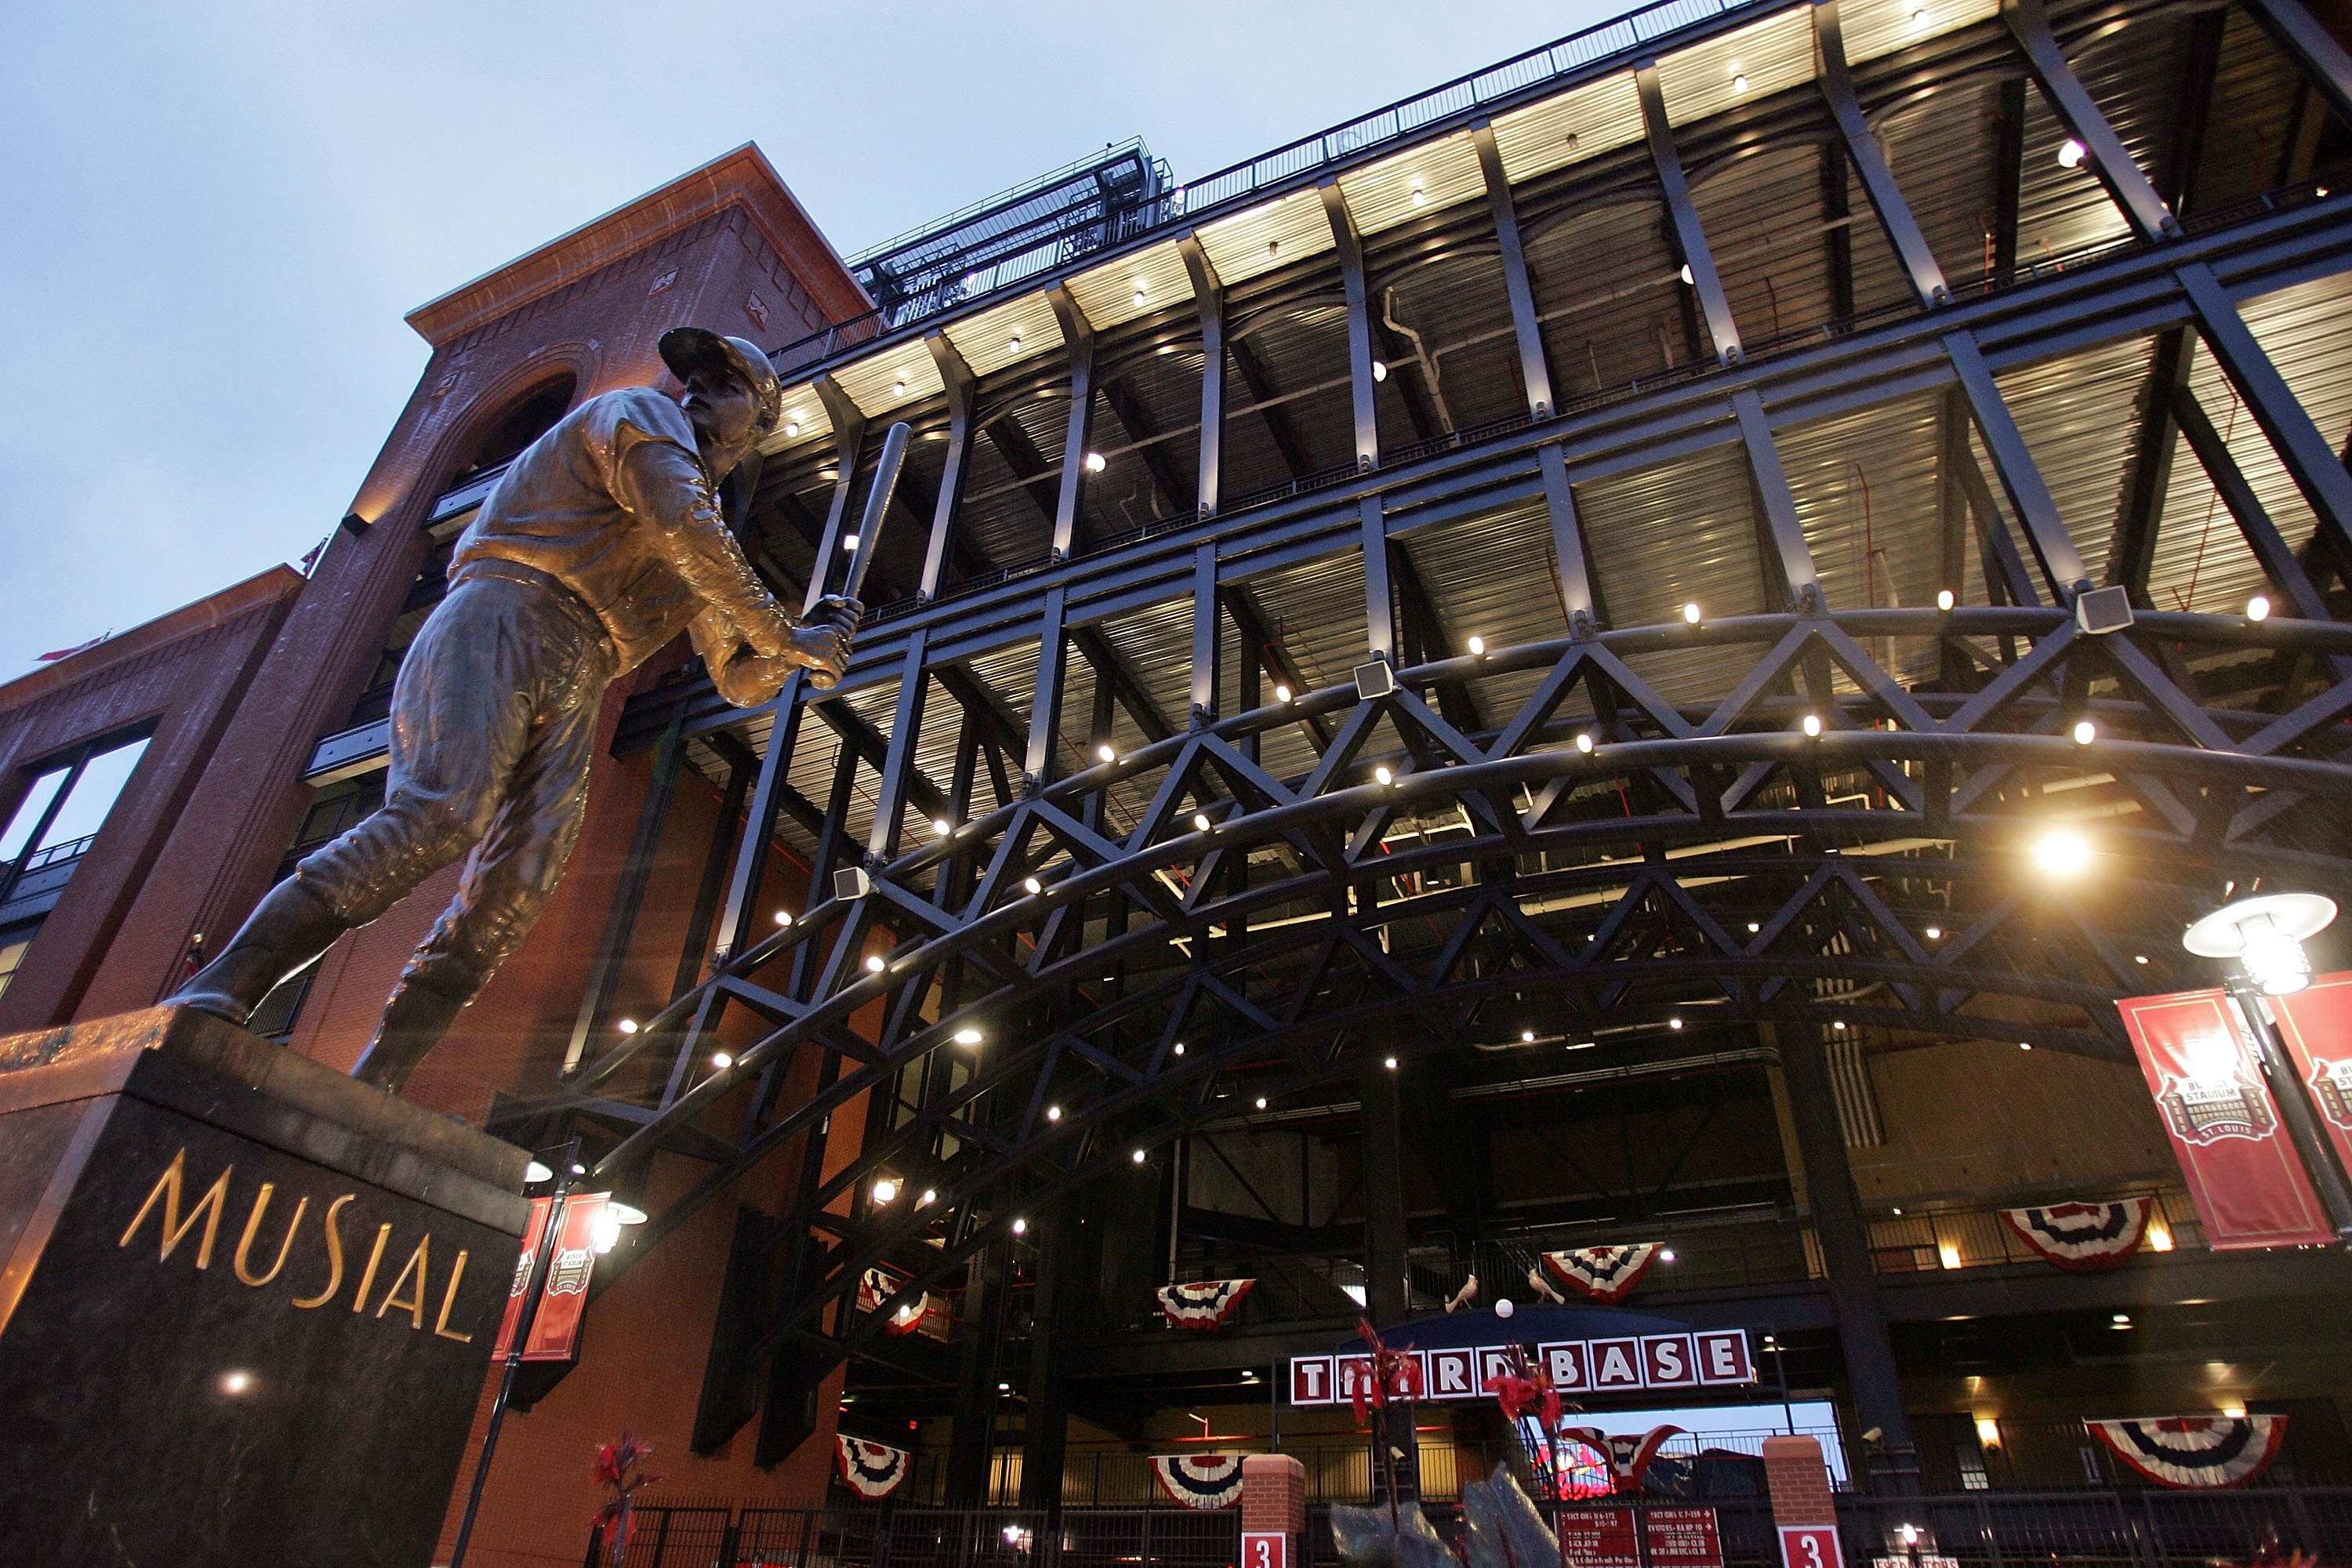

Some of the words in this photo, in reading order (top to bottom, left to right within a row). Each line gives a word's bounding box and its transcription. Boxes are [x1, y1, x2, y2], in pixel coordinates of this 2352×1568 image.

[2186, 1088, 2237, 1102] STADIUM
[2201, 1129, 2217, 1139] ST.
[2218, 1124, 2252, 1134] LOUIS
[118, 1147, 471, 1343] MUSIAL
[1550, 1338, 1737, 1385] BASE
[1256, 1540, 1271, 1568] 3
[1800, 1534, 1824, 1568] 3
